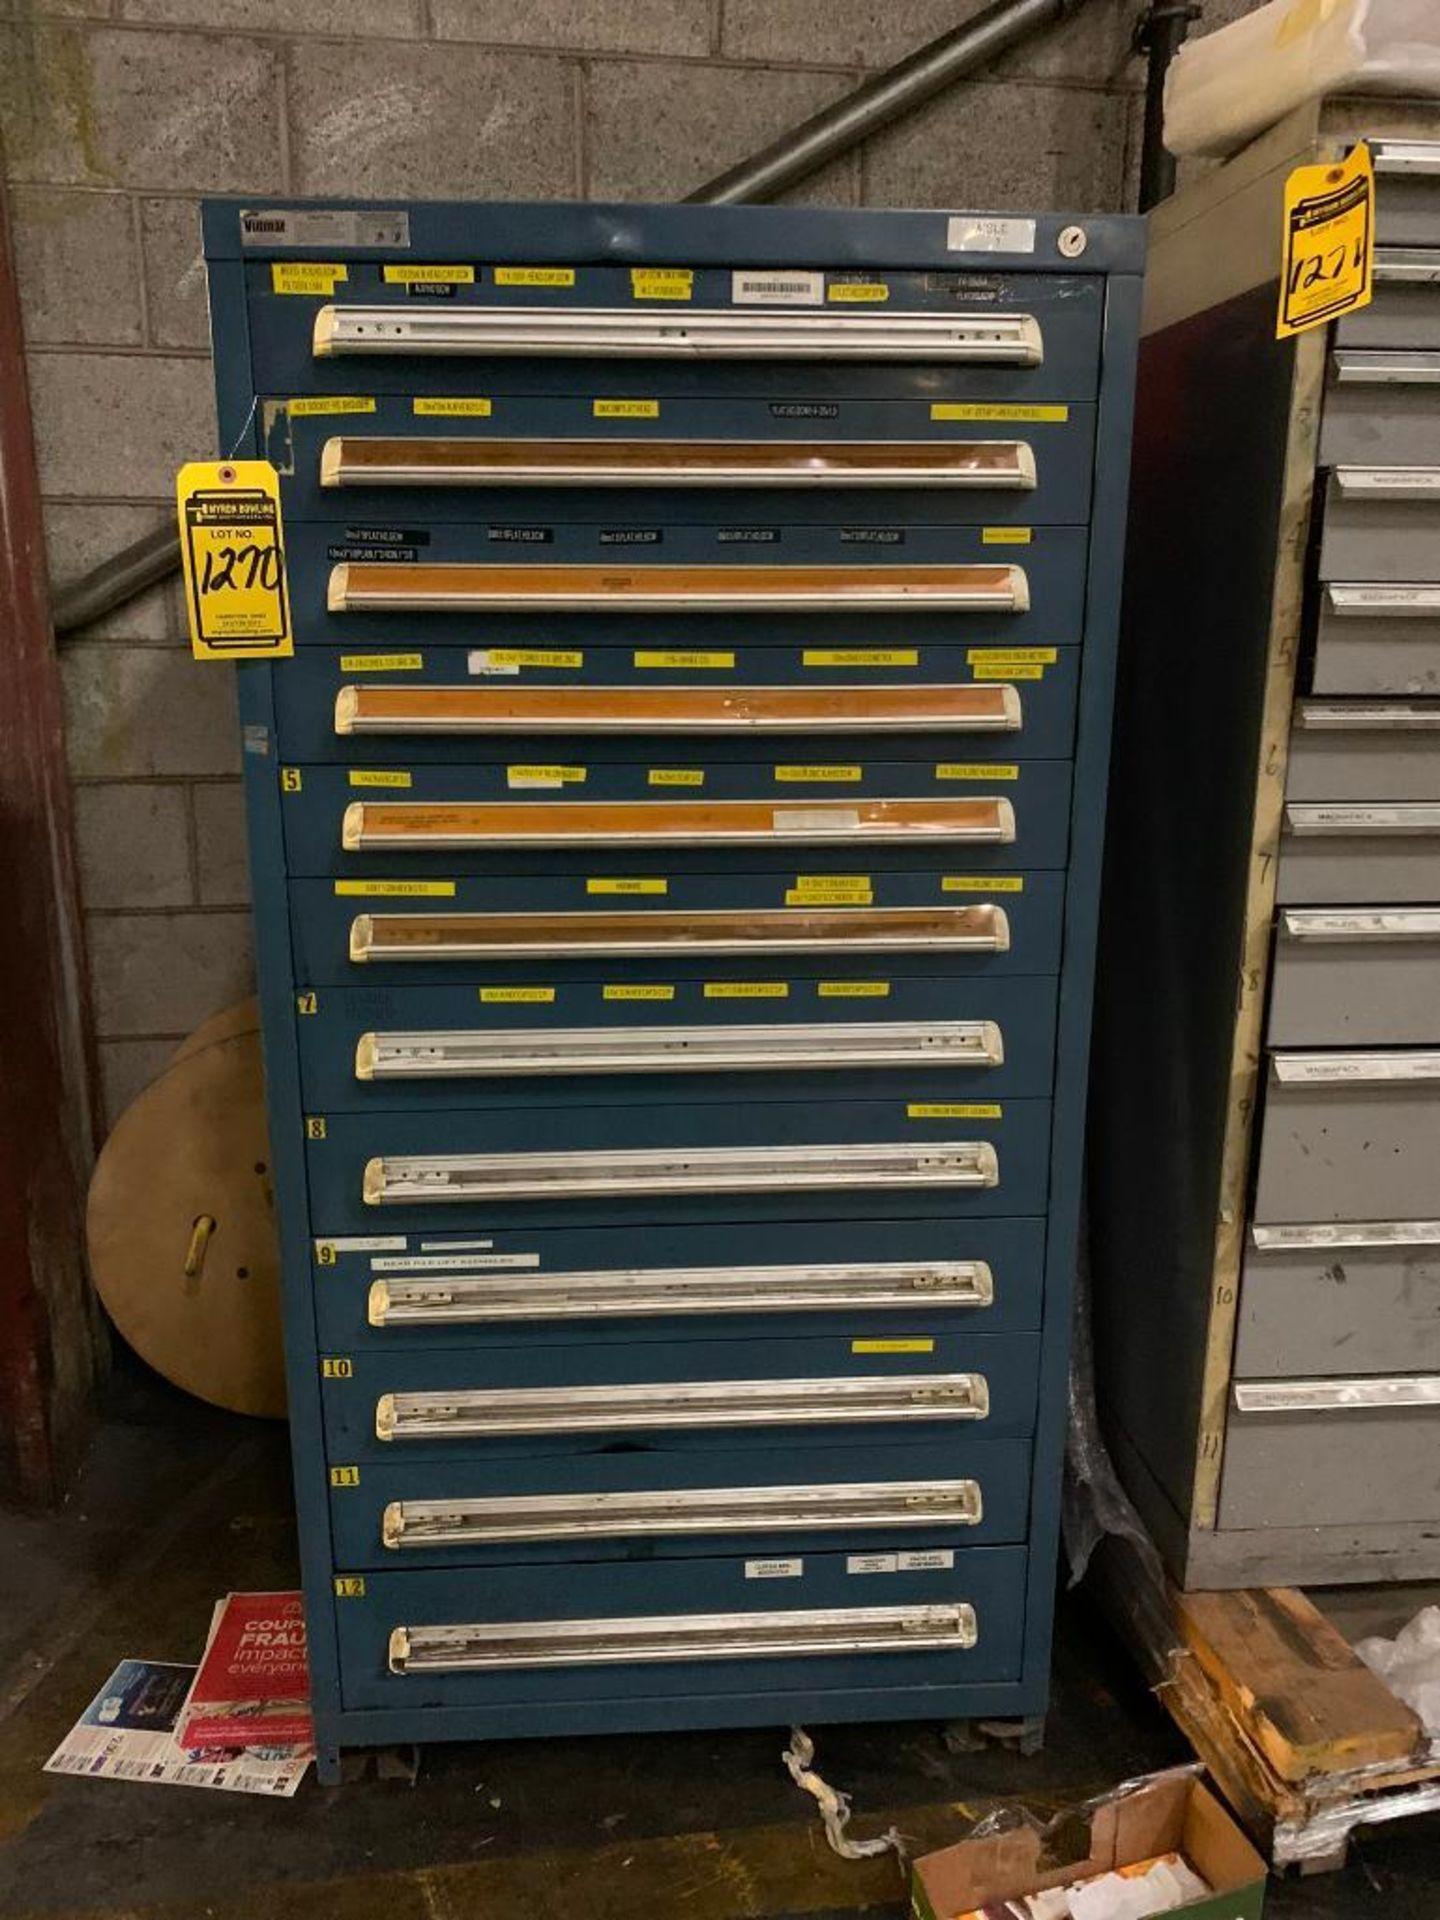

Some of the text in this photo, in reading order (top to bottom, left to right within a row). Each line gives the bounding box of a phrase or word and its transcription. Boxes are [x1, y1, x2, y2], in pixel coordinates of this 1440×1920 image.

[1288, 237, 1361, 295] 1271
[210, 529, 255, 540] LOT NO.
[201, 543, 284, 596] 1270
[286, 770, 298, 790] 5
[311, 1119, 323, 1139] 8
[320, 1246, 331, 1264] 9
[1215, 1285, 1234, 1305] 10
[327, 1360, 349, 1377] 10
[334, 1469, 357, 1484] 11
[340, 1580, 362, 1595] 12
